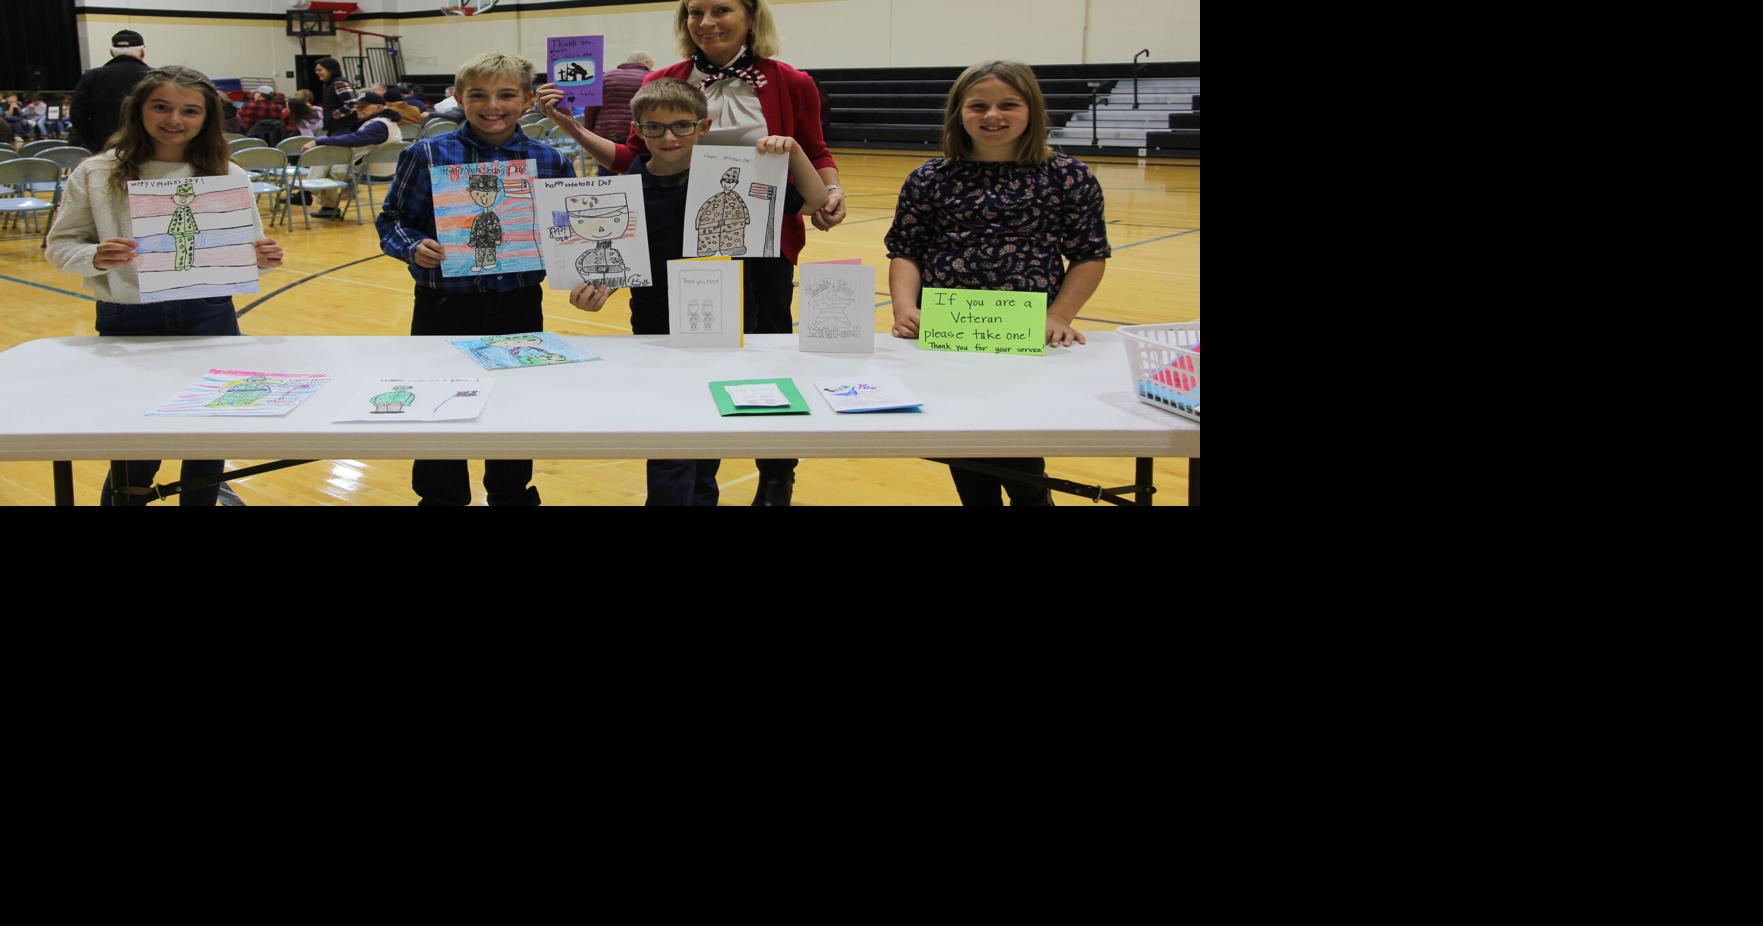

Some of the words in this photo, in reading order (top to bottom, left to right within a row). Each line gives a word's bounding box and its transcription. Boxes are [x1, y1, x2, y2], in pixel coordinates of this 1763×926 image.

[934, 292, 957, 306] If
[966, 299, 984, 310] you
[995, 298, 1016, 307] are
[1023, 300, 1033, 309] a
[950, 311, 1003, 324] Veteran
[924, 328, 965, 342] please
[972, 329, 1001, 340] take
[1006, 327, 1031, 341] one!
[928, 341, 952, 350] Thank
[974, 343, 988, 351] for
[995, 345, 1012, 354] your
